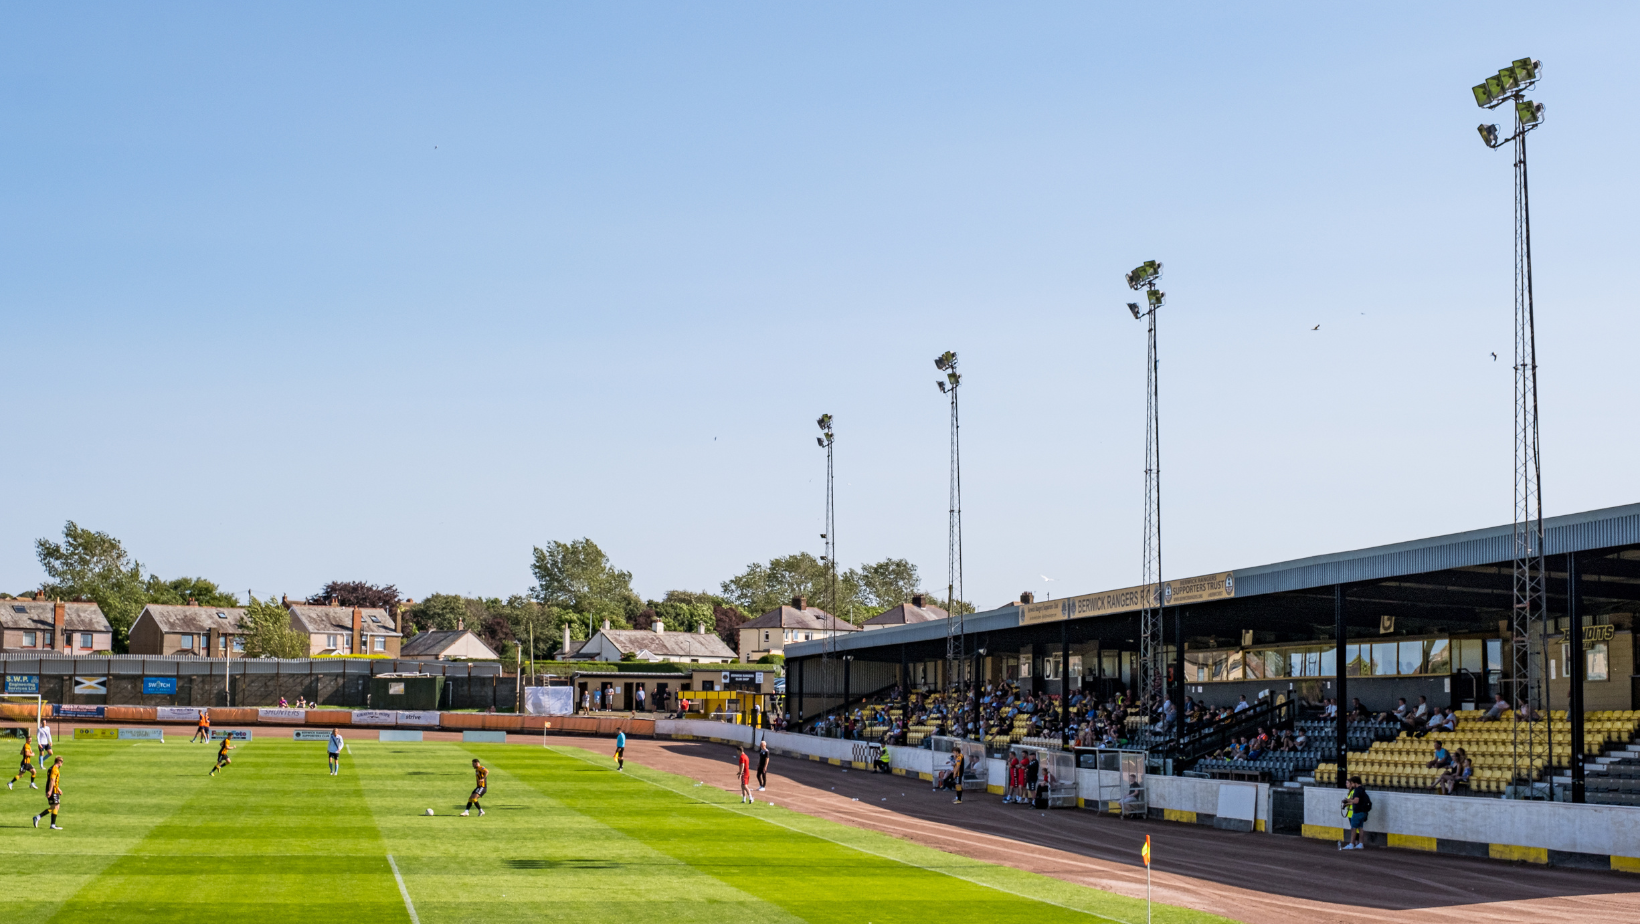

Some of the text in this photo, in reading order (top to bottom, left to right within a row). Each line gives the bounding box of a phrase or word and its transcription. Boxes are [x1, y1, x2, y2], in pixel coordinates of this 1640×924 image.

[1172, 583, 1206, 596] SUPPORTERS
[1207, 580, 1225, 591] TRUST
[1078, 595, 1106, 613] BERWICK
[1107, 590, 1138, 609] RANGERS
